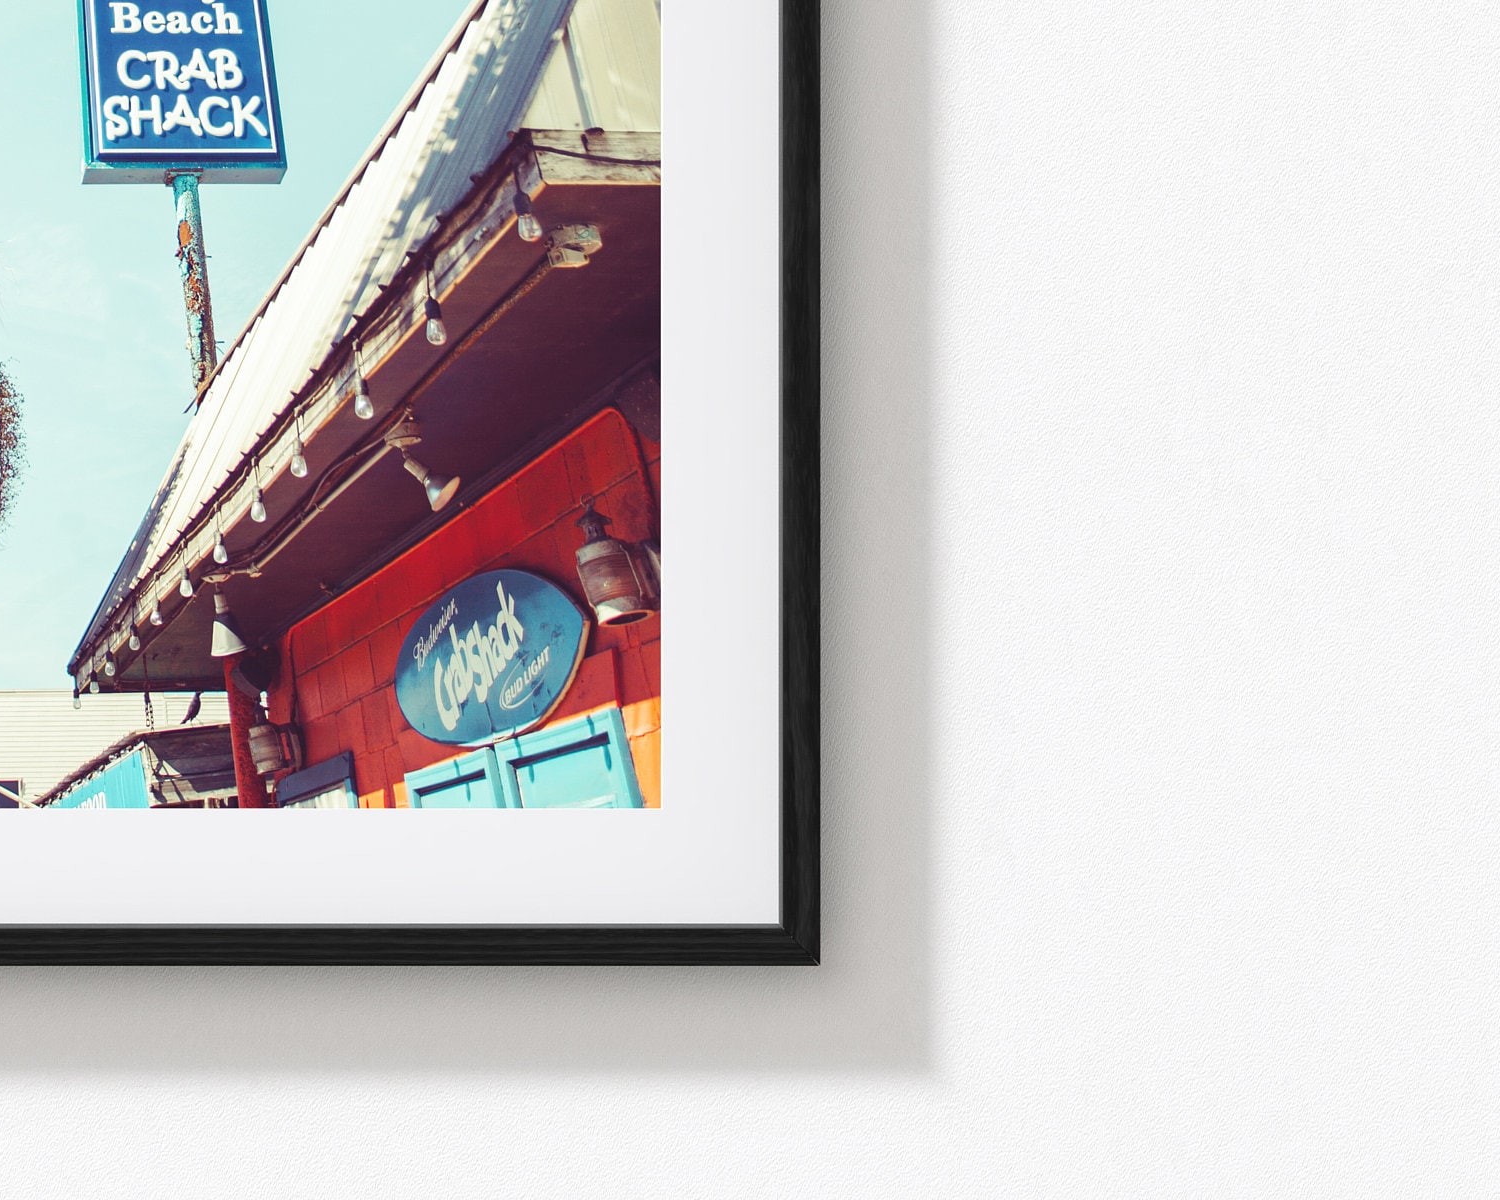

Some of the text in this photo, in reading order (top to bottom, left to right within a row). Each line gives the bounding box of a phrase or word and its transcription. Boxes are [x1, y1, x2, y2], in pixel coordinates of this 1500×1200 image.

[109, 2, 242, 34] Beach
[116, 48, 243, 90] CRAB
[103, 94, 268, 141] SHACK
[503, 645, 550, 705] BUD LIGHT
